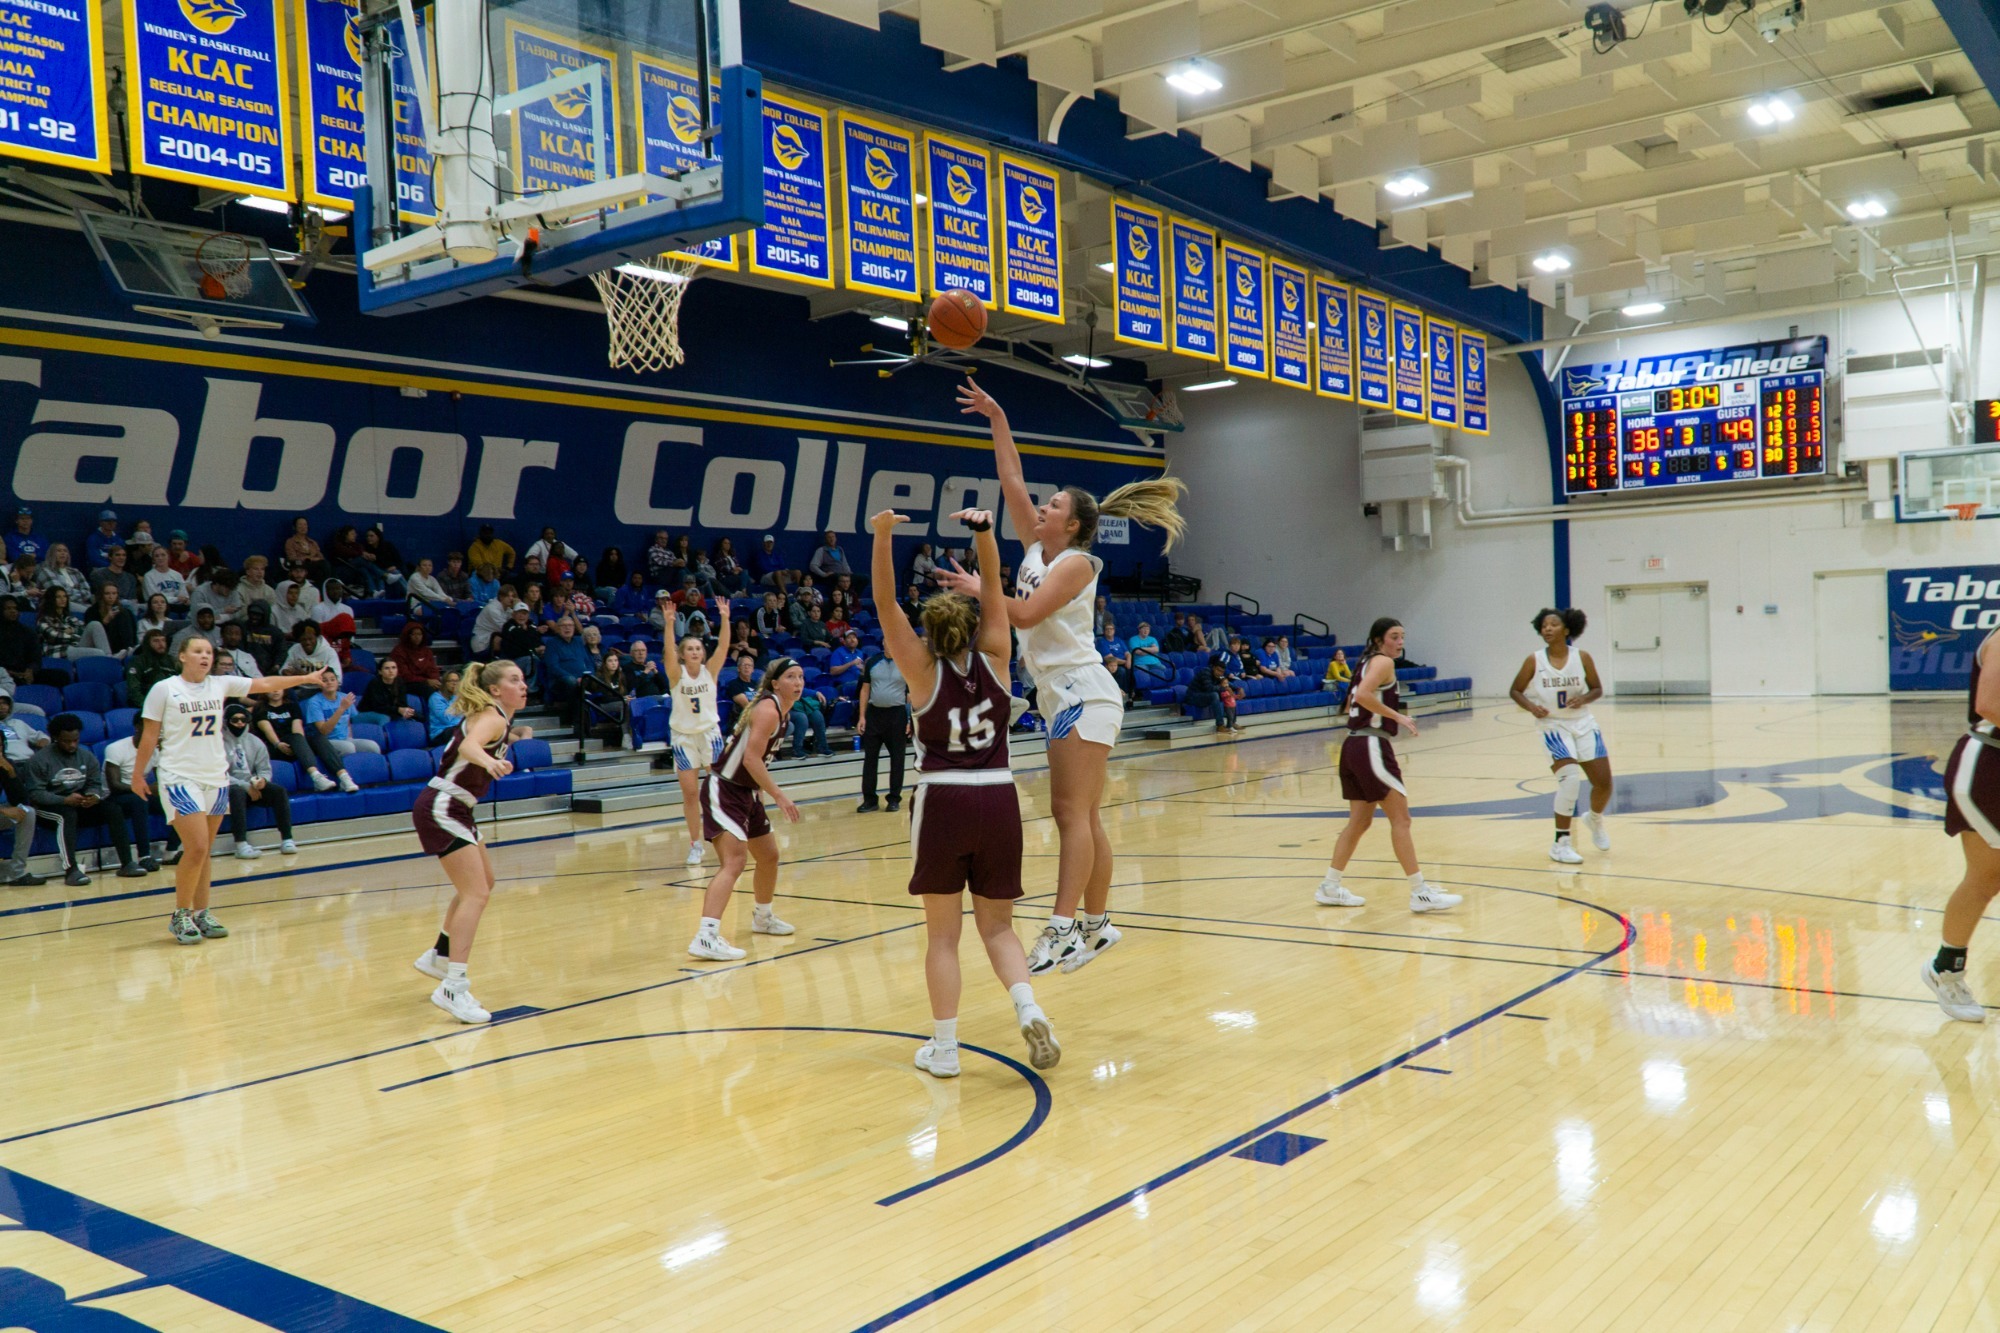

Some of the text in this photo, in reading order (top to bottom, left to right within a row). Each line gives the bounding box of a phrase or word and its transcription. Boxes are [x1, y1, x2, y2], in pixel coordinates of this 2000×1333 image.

[0, 10, 32, 29] CAC
[16, 31, 65, 52] SEASON
[144, 22, 271, 62] WOMEN'S BASKETBALL
[519, 39, 558, 62] TABOR
[168, 46, 253, 89] KCAC
[316, 63, 361, 82] WOMEN'S
[0, 76, 51, 97] TRICT 10
[644, 72, 678, 91] TABOR
[0, 90, 48, 109] AMPION
[150, 77, 274, 116] REGULAR SEASON
[147, 101, 279, 146] CHAMPION
[524, 110, 560, 128] WOMEN'S
[784, 113, 820, 132] COLLEGE
[647, 137, 680, 153] WOMEN'S
[848, 127, 908, 153] TABOR COLLEGE
[159, 135, 271, 175] 2004-05
[319, 135, 431, 177] CHAION
[932, 145, 984, 170] TABOR COLLEGE
[780, 182, 800, 195] KCAC
[785, 172, 823, 188] BASKETBALL
[1006, 168, 1053, 191] TABOR COLLEGE
[850, 184, 910, 206] WOMEN'S BASKETBALL
[809, 201, 822, 210] AND
[861, 200, 901, 225] KCAC
[781, 215, 802, 228] NAIA
[943, 214, 980, 239] KCAC
[1117, 210, 1159, 229] TABOR COLLEGE
[787, 228, 825, 243] TOURNAMENT
[853, 221, 910, 243] TOURNAMENT
[1192, 233, 1213, 246] COLLEGE
[852, 238, 913, 263] CHAMPION
[936, 234, 988, 256] TOURNAMENT
[1017, 233, 1049, 256] KCAC
[767, 245, 820, 269] 2015-16
[936, 250, 990, 274] CHAMPION
[861, 261, 908, 283] 2016-17
[1009, 268, 1059, 290] CHAMPION
[1126, 269, 1154, 289] KCAC
[944, 272, 985, 292] 2017-18
[1016, 287, 1054, 307] 2018-19
[1121, 286, 1160, 303] TOURNAMENT
[1183, 284, 1209, 303] KCAC
[1120, 300, 1161, 320] CHAMPION
[1234, 304, 1257, 323] KCAC
[1132, 321, 1151, 335] 2017
[1177, 313, 1216, 332] CHAMPION
[1280, 319, 1302, 337] KCAC
[1188, 333, 1207, 347] 2013
[1229, 333, 1264, 351] CHAMPION
[1324, 334, 1345, 350] KCAC
[1237, 351, 1257, 365] 2009
[1276, 345, 1307, 363] CHAMPION
[1365, 345, 1384, 360] KCAC
[1605, 354, 1810, 393] Tabor College
[1785, 377, 1796, 386] FLS
[1803, 375, 1815, 384] PTS
[1671, 386, 1719, 411] 3:04
[1811, 400, 1820, 413] 3
[1717, 406, 1751, 419] GUEST
[1767, 404, 1782, 418] 12
[1787, 403, 1796, 416] 2
[1627, 417, 1656, 429] HOME
[1675, 417, 1700, 426] PERIOD
[1723, 419, 1754, 440] 49
[1767, 419, 1783, 432] 13
[0, 355, 560, 520] abor
[1633, 428, 1660, 452] 36
[1683, 427, 1694, 446] 3
[1767, 433, 1783, 446] 15
[1788, 431, 1797, 445] 3
[1805, 429, 1820, 443] 13
[1665, 446, 1711, 458] PLAYER FOUL
[1732, 442, 1755, 451] FOULS
[1765, 447, 1783, 462] 30
[1788, 446, 1797, 460] 3
[1624, 453, 1645, 462] FOULS
[1716, 456, 1727, 471] 5
[1742, 450, 1754, 469] 3
[1788, 460, 1797, 474] 3
[1631, 461, 1643, 476] 4
[1650, 461, 1660, 476] 2
[1733, 470, 1756, 479] SCORE
[1624, 479, 1645, 488] SCORE
[1676, 475, 1701, 483] MATCH
[1099, 519, 1127, 527] BLUEJAY
[1105, 530, 1123, 538] BAND
[1902, 575, 2000, 603] Tabo
[1542, 676, 1580, 688] BLUEJAYS
[690, 697, 701, 714] 3
[1557, 691, 1567, 709] 0
[190, 715, 217, 737] 22
[947, 698, 996, 752] 15
